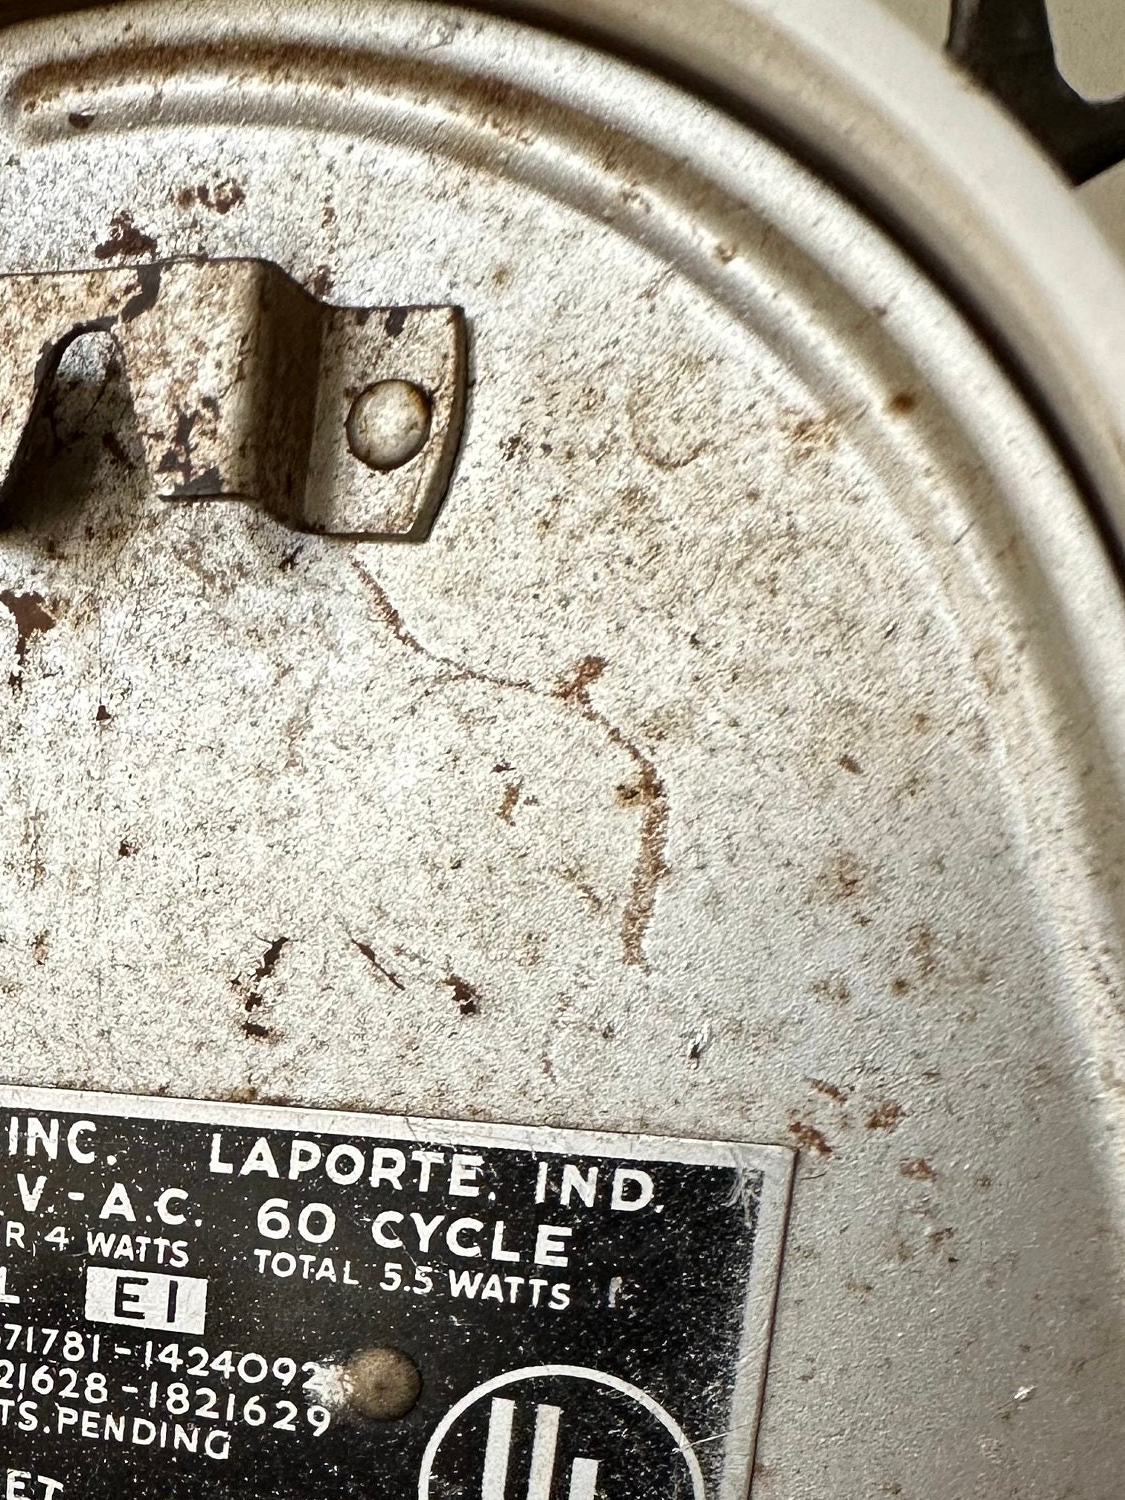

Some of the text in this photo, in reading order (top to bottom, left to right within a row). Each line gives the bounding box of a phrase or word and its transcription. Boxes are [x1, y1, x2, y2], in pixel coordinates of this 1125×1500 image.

[8, 1116, 117, 1165] INC.
[534, 1161, 664, 1213] IND.
[44, 1226, 69, 1251] 4
[87, 1231, 189, 1268] WATTS
[253, 1249, 359, 1285] TOTAL
[379, 1262, 434, 1295] 5.5
[448, 1268, 571, 1311] WATTS
[257, 1198, 336, 1244] 60
[371, 1210, 572, 1268] CYCLE
[55, 1403, 230, 1459] PENDING
